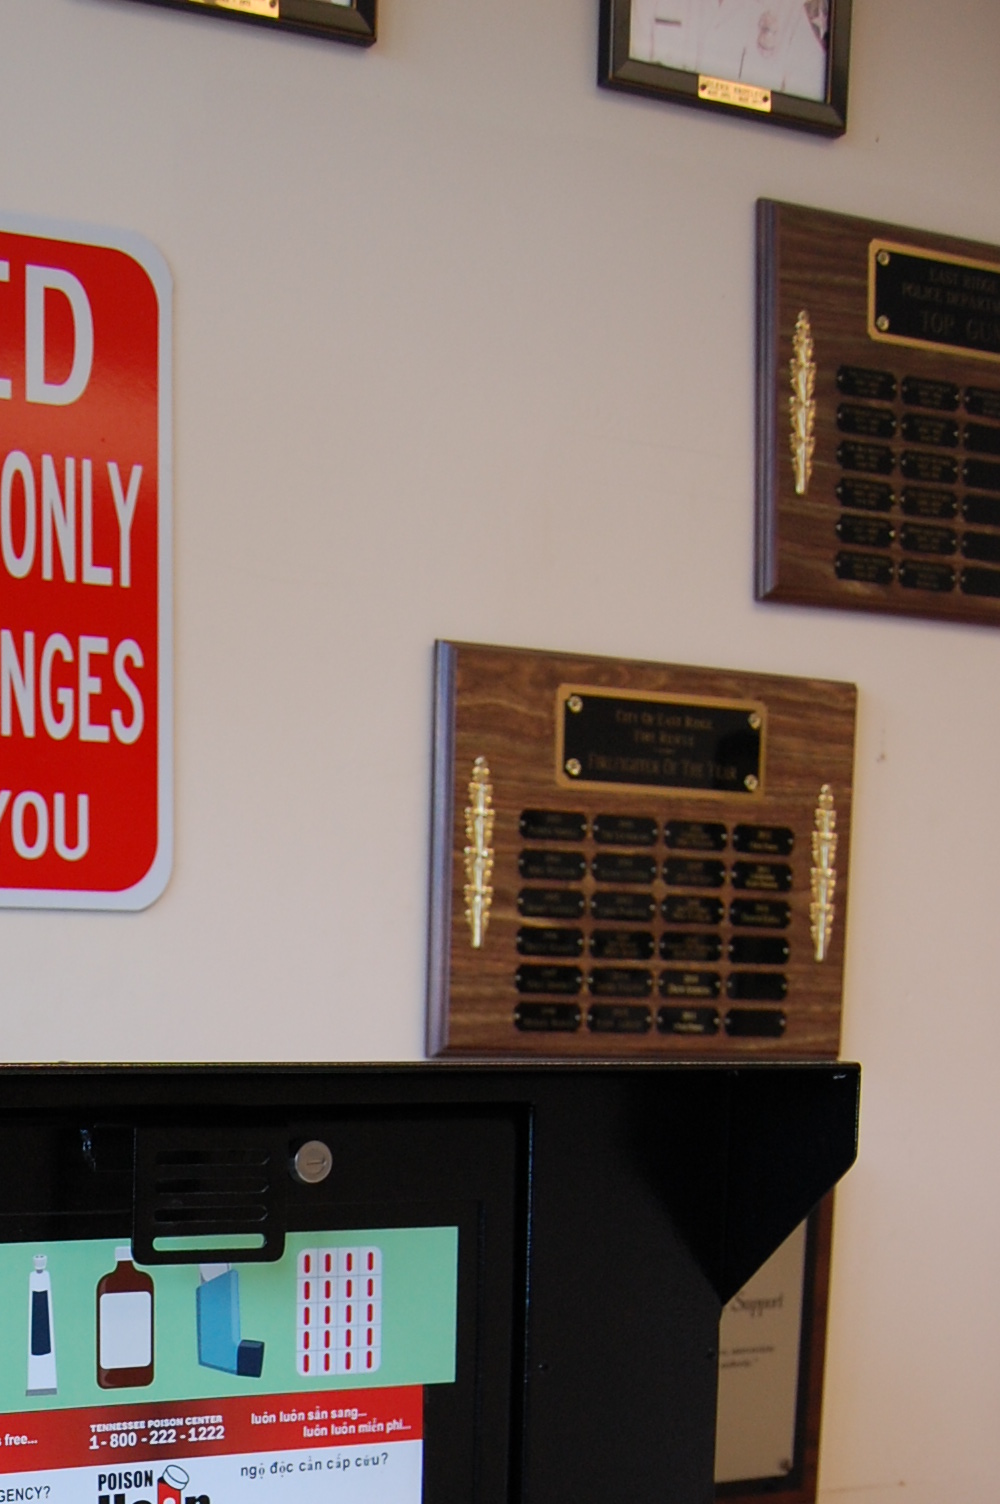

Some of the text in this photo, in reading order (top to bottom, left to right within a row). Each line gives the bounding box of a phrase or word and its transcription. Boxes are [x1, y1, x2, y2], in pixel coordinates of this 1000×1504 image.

[0, 449, 143, 588] ONLY
[90, 1414, 223, 1433] TENNESSEE POISON CENTER
[4, 1433, 38, 1447] free...
[98, 1470, 154, 1491] POISON
